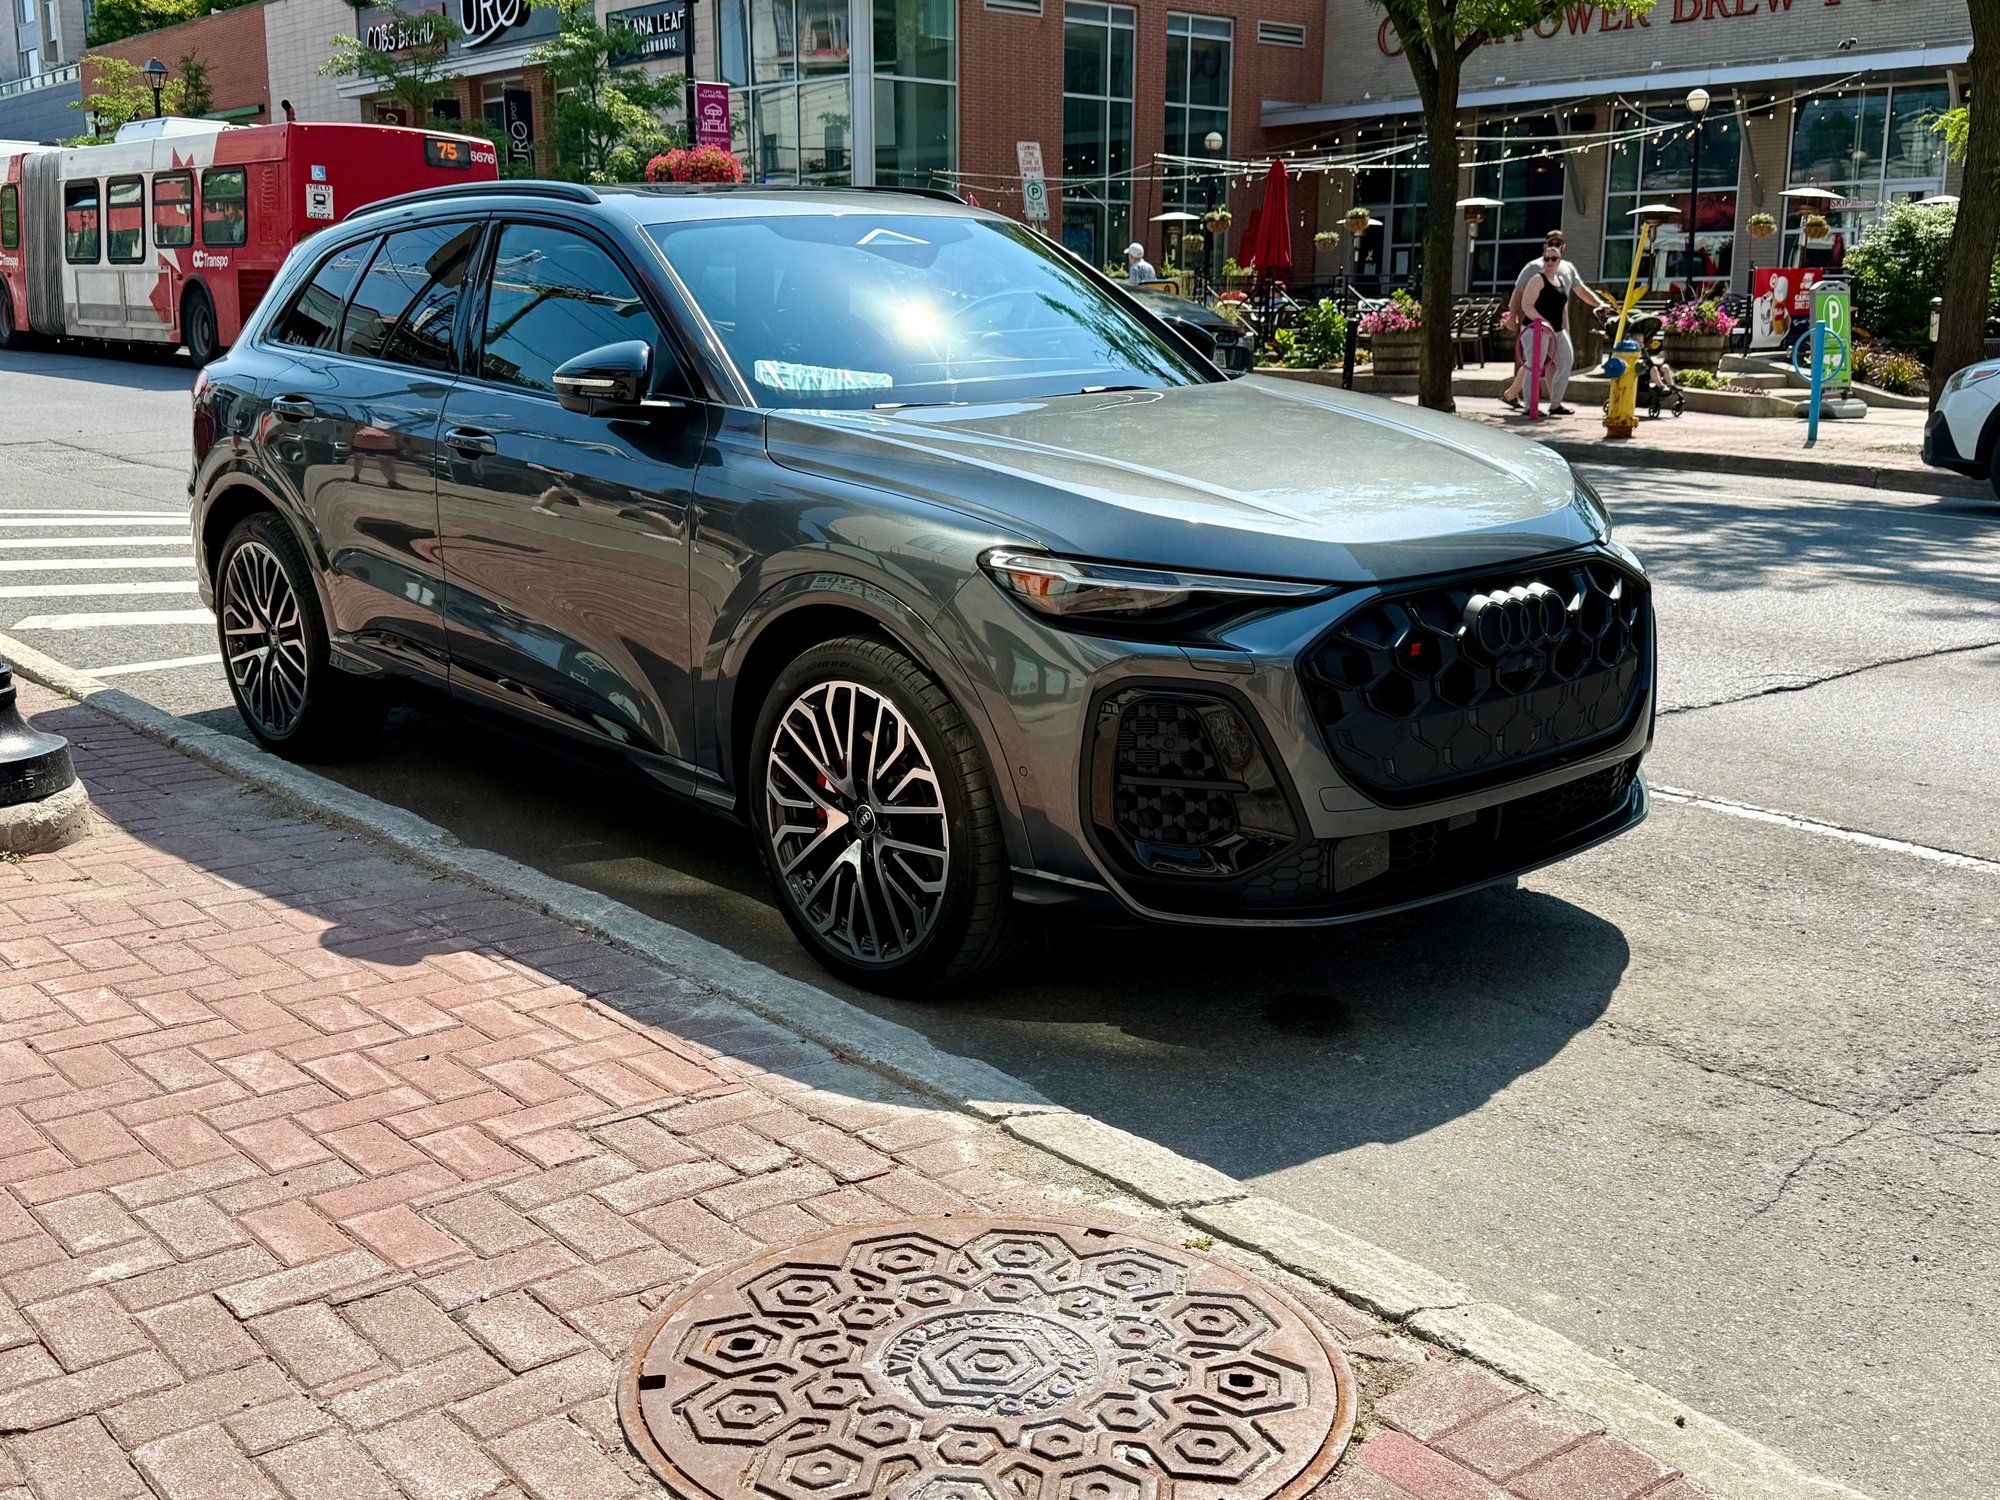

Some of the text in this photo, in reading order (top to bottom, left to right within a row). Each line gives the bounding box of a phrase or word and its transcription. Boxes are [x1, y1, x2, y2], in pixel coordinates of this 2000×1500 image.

[657, 8, 685, 33] LEAF
[367, 23, 395, 52] COBS
[641, 36, 676, 54] CANNABIS
[437, 142, 458, 160] 75
[470, 151, 495, 164] 6676
[1830, 198, 1850, 208] SKIP
[204, 251, 229, 270] Transpo
[1828, 301, 1839, 333] P
